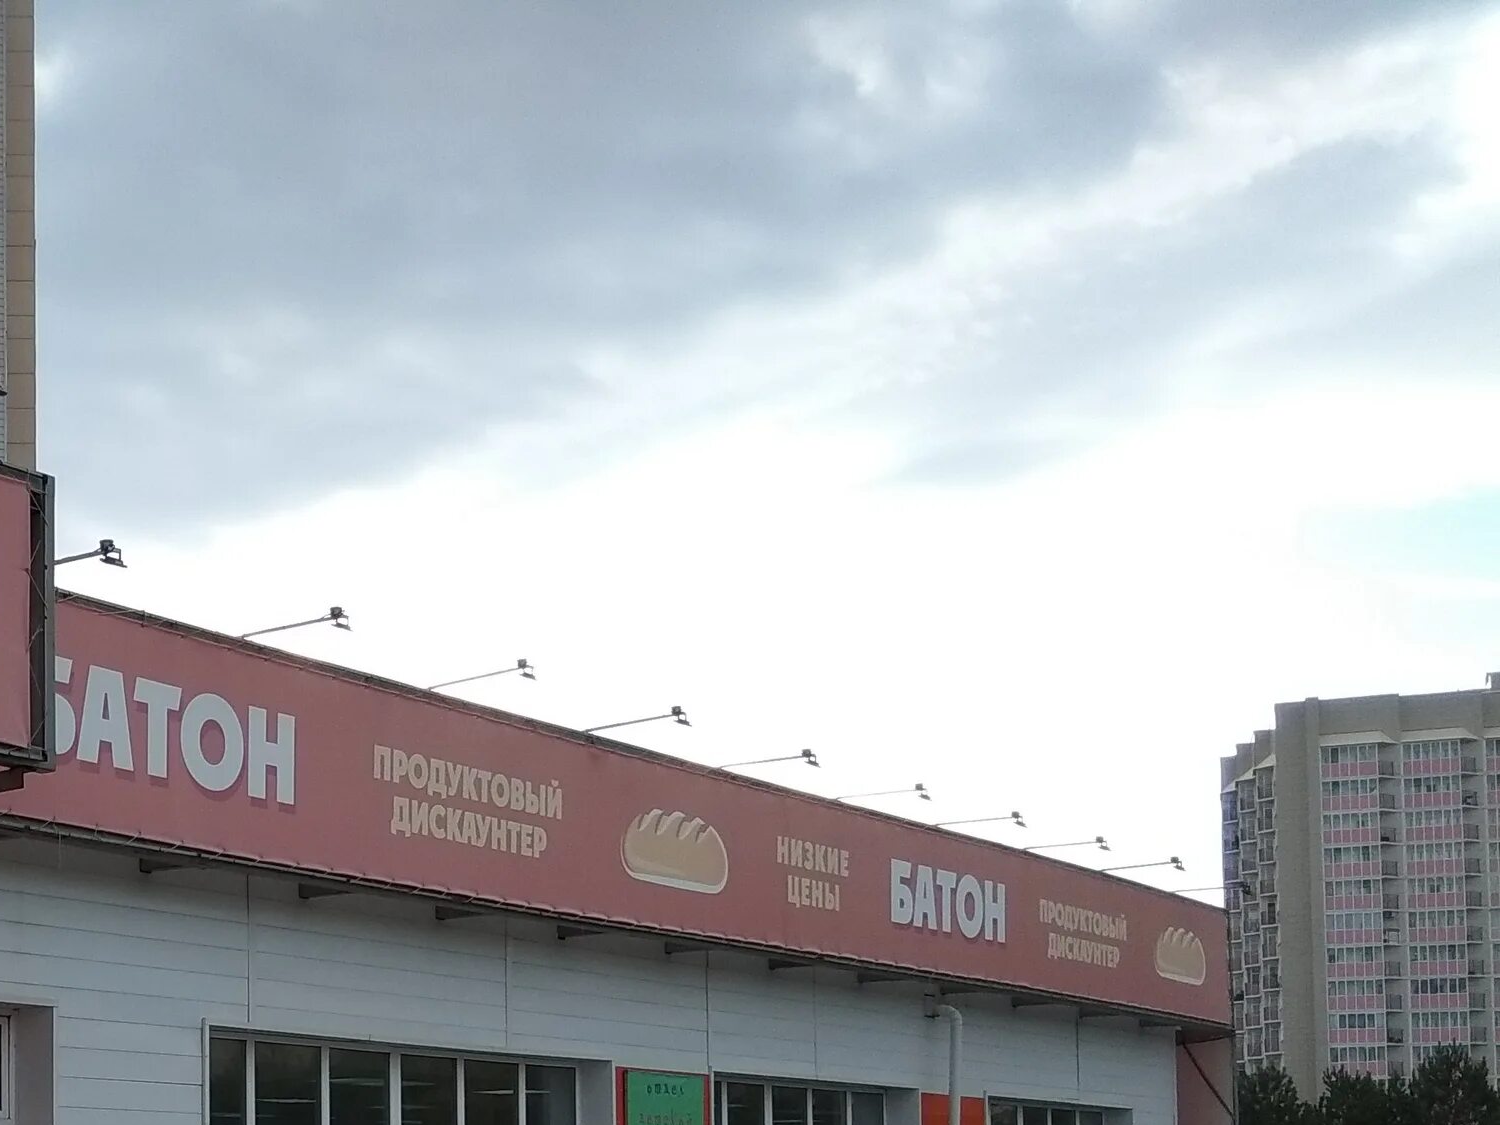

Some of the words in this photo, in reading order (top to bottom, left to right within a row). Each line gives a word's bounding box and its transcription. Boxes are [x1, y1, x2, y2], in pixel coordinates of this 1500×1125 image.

[373, 744, 563, 820] ПРОДУКТОВЫЙ
[391, 796, 548, 858] ДИСКАУНТЕР
[777, 836, 849, 877] НИЗКИЕ
[787, 874, 840, 912] ЦЕНЫ
[890, 858, 1006, 943] БАТОН
[1040, 898, 1127, 941] ПРОДУКТОВЫЙ
[1047, 932, 1120, 969] ДИСКАУНТЕР
